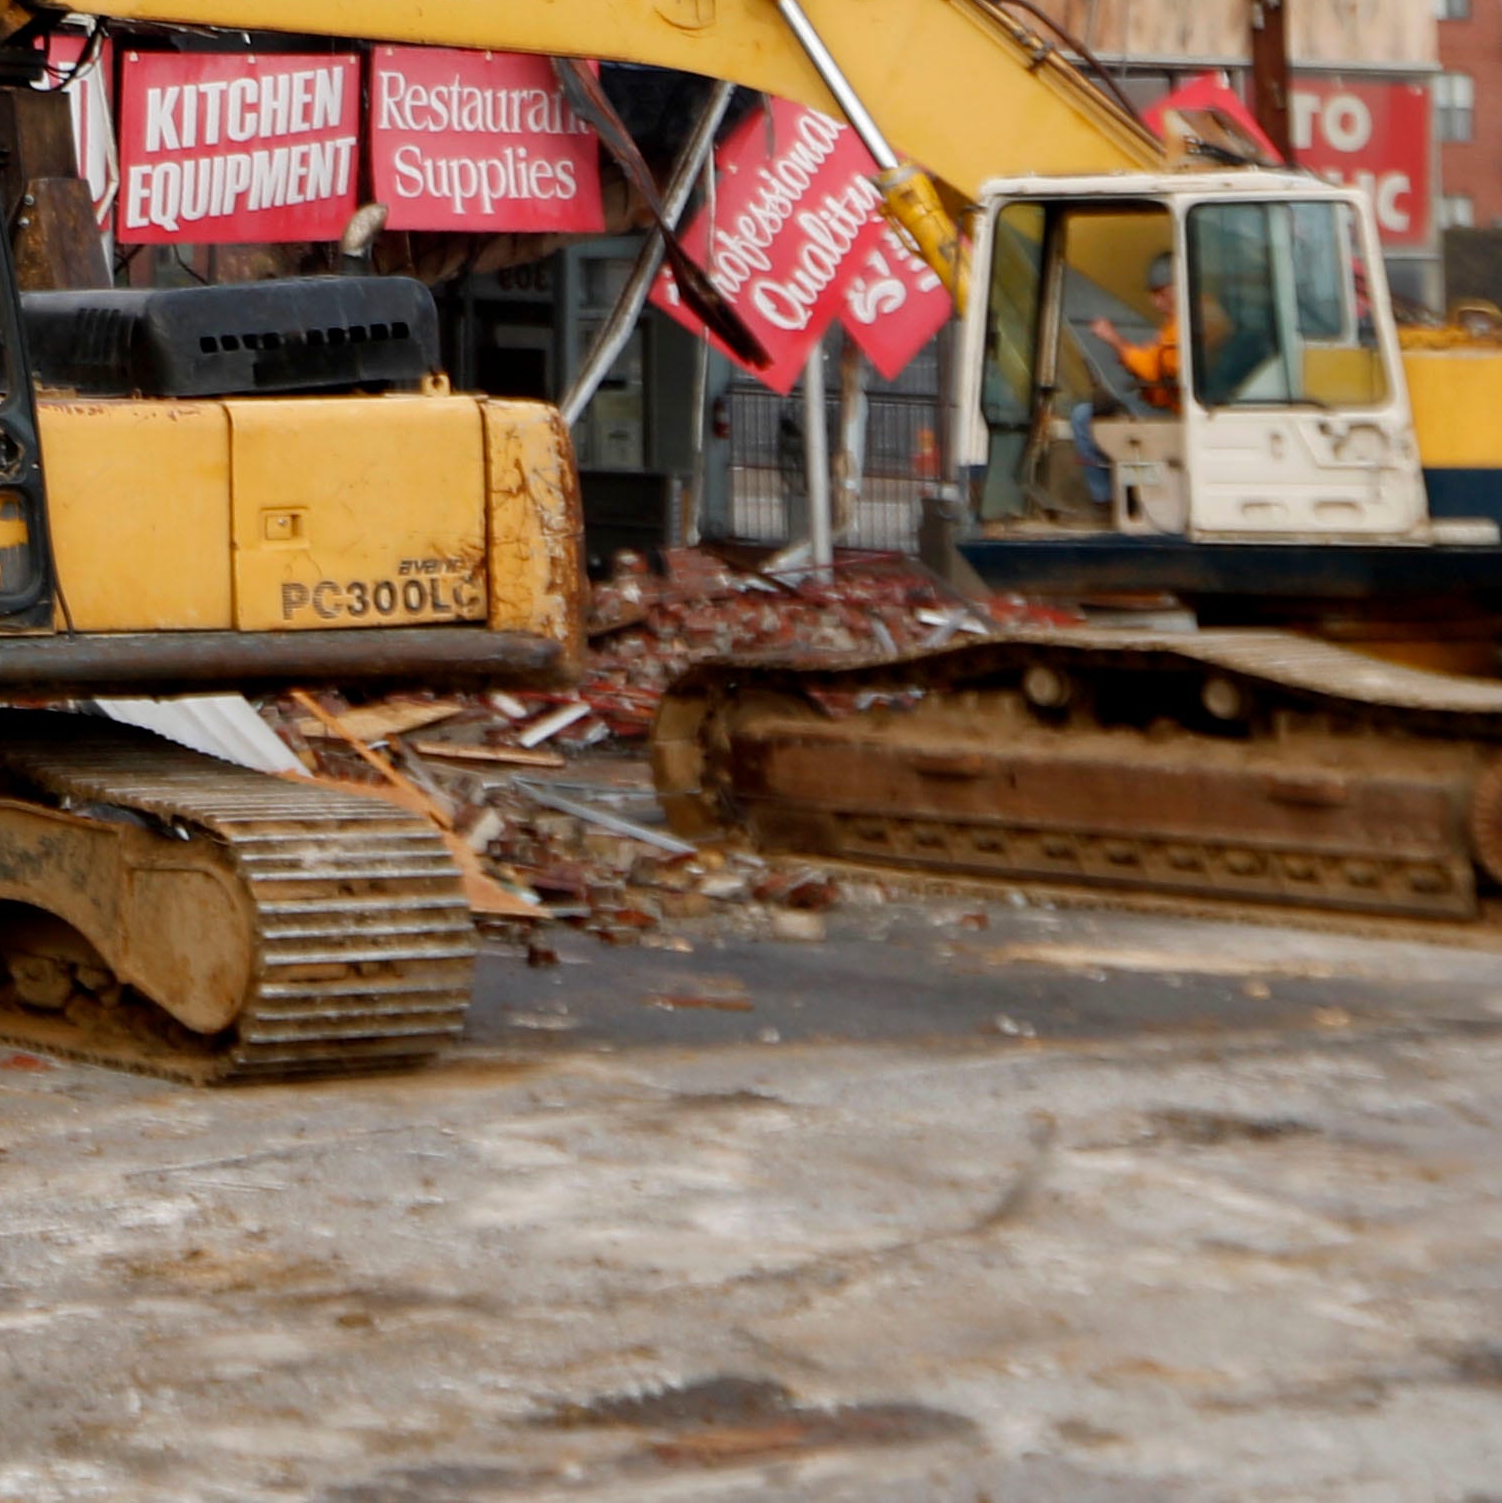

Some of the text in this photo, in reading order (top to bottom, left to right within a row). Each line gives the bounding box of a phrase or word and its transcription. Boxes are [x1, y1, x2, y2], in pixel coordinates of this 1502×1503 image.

[145, 65, 345, 154] KITCHEN
[378, 70, 591, 136] Restauran
[125, 135, 357, 232] EQUIPMENT
[393, 144, 578, 215] Supplies
[664, 107, 849, 306] rofessional
